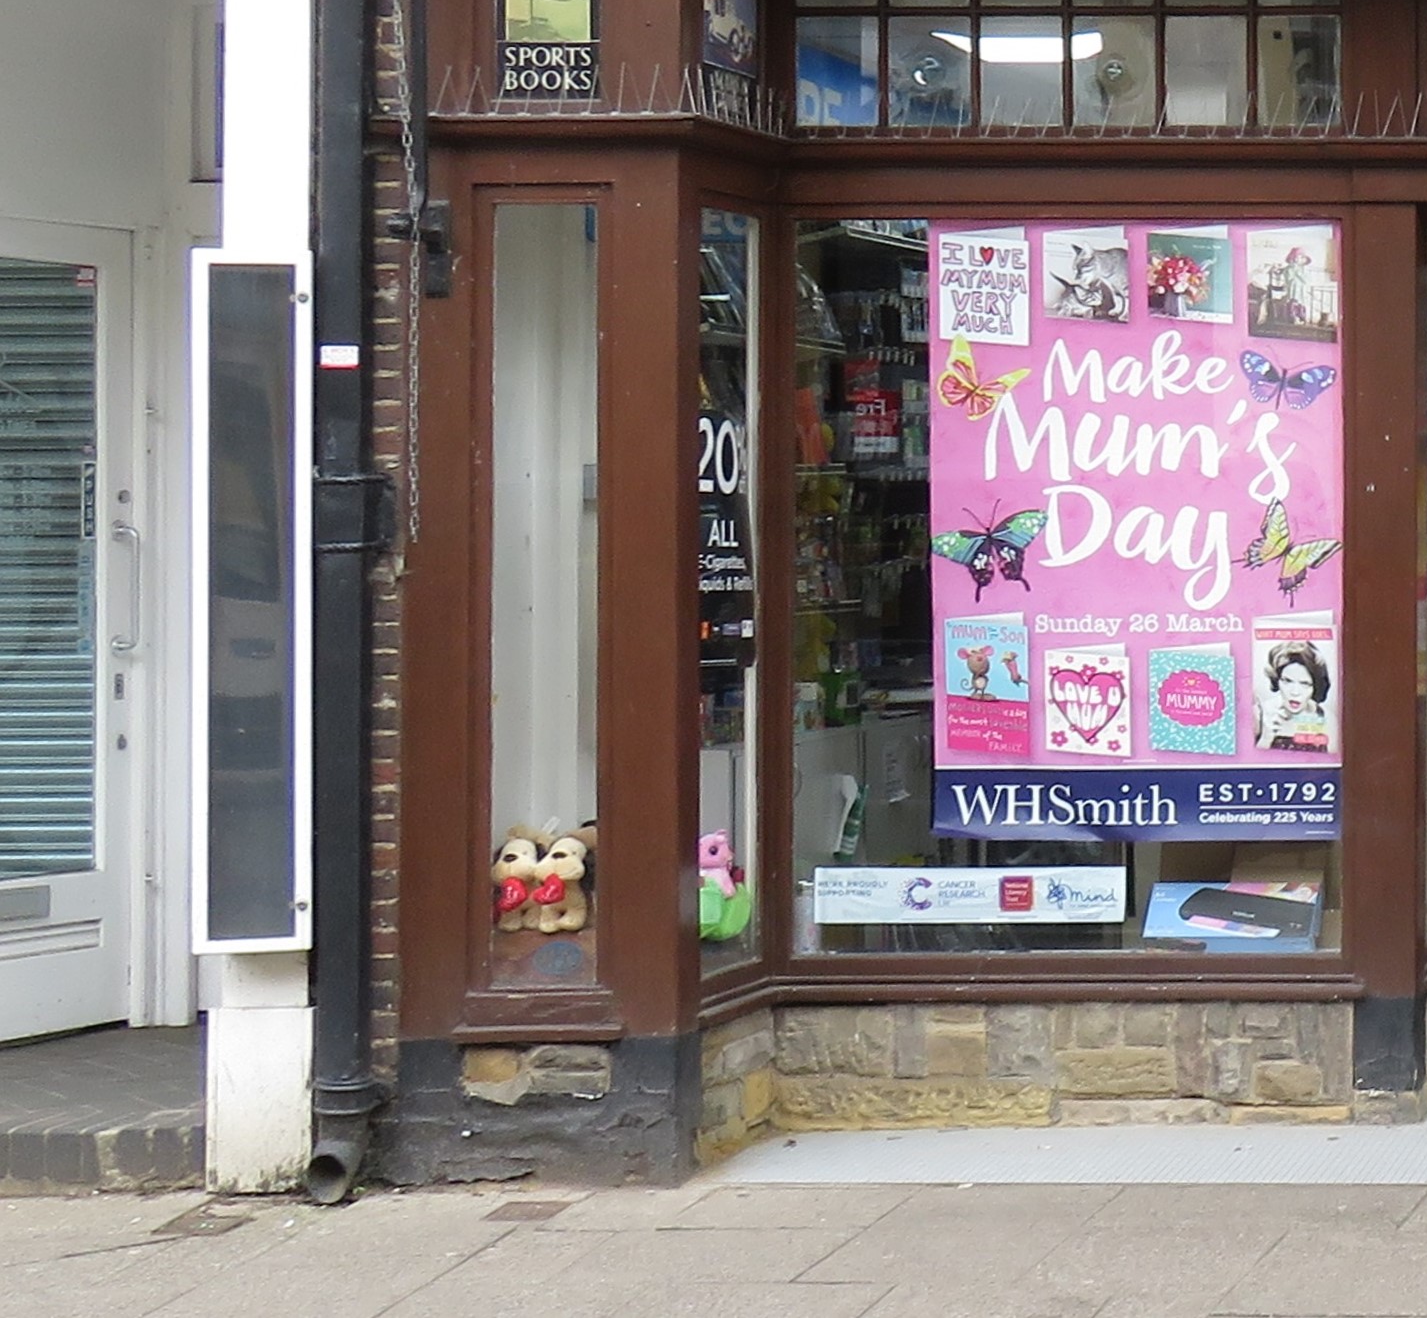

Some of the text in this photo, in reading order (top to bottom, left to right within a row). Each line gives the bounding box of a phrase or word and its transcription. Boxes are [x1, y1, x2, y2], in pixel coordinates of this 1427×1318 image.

[504, 46, 592, 68] SPORTS
[503, 69, 592, 92] BOOKS
[941, 242, 964, 266] I
[940, 268, 1027, 294] MY MUM
[951, 289, 1018, 318] VERY
[951, 311, 1014, 336] MUCH
[1042, 329, 1236, 404] Make
[984, 389, 1297, 505] Mum's
[707, 519, 740, 548] ALL
[1038, 483, 1233, 611] Day
[1034, 613, 1244, 637] Sunday 26 March
[1053, 679, 1122, 707] LOVE U
[1165, 692, 1218, 711] MUMMY
[1066, 701, 1108, 732] MUM
[951, 783, 1178, 826] WHSmith
[1198, 811, 1334, 824] Celebrating 225 Years
[937, 881, 976, 889] CANCER
[938, 889, 986, 898] RESEARCH
[1069, 888, 1118, 902] mind
